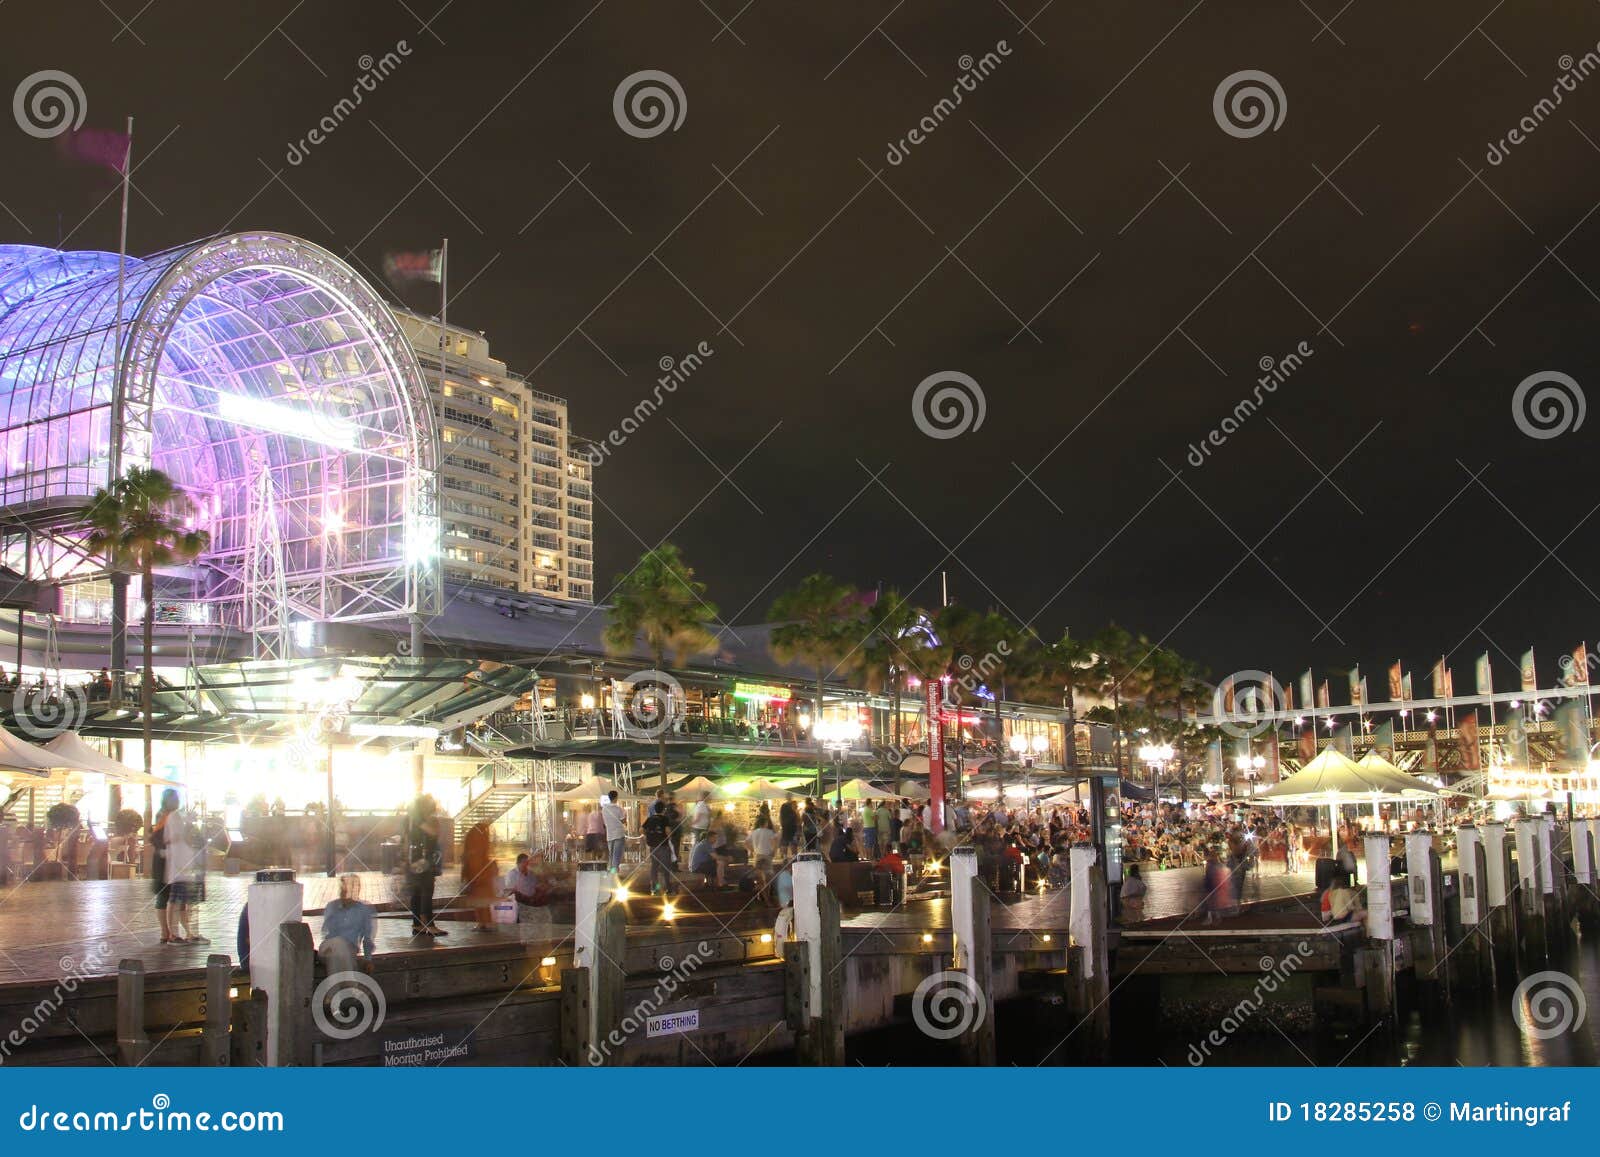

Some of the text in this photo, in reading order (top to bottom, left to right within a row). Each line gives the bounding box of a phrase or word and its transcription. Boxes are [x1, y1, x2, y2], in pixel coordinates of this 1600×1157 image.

[649, 1014, 697, 1032] NO BERTHING
[384, 1033, 444, 1052] Unauthorised
[384, 1044, 469, 1067] Mooring Prohibited
